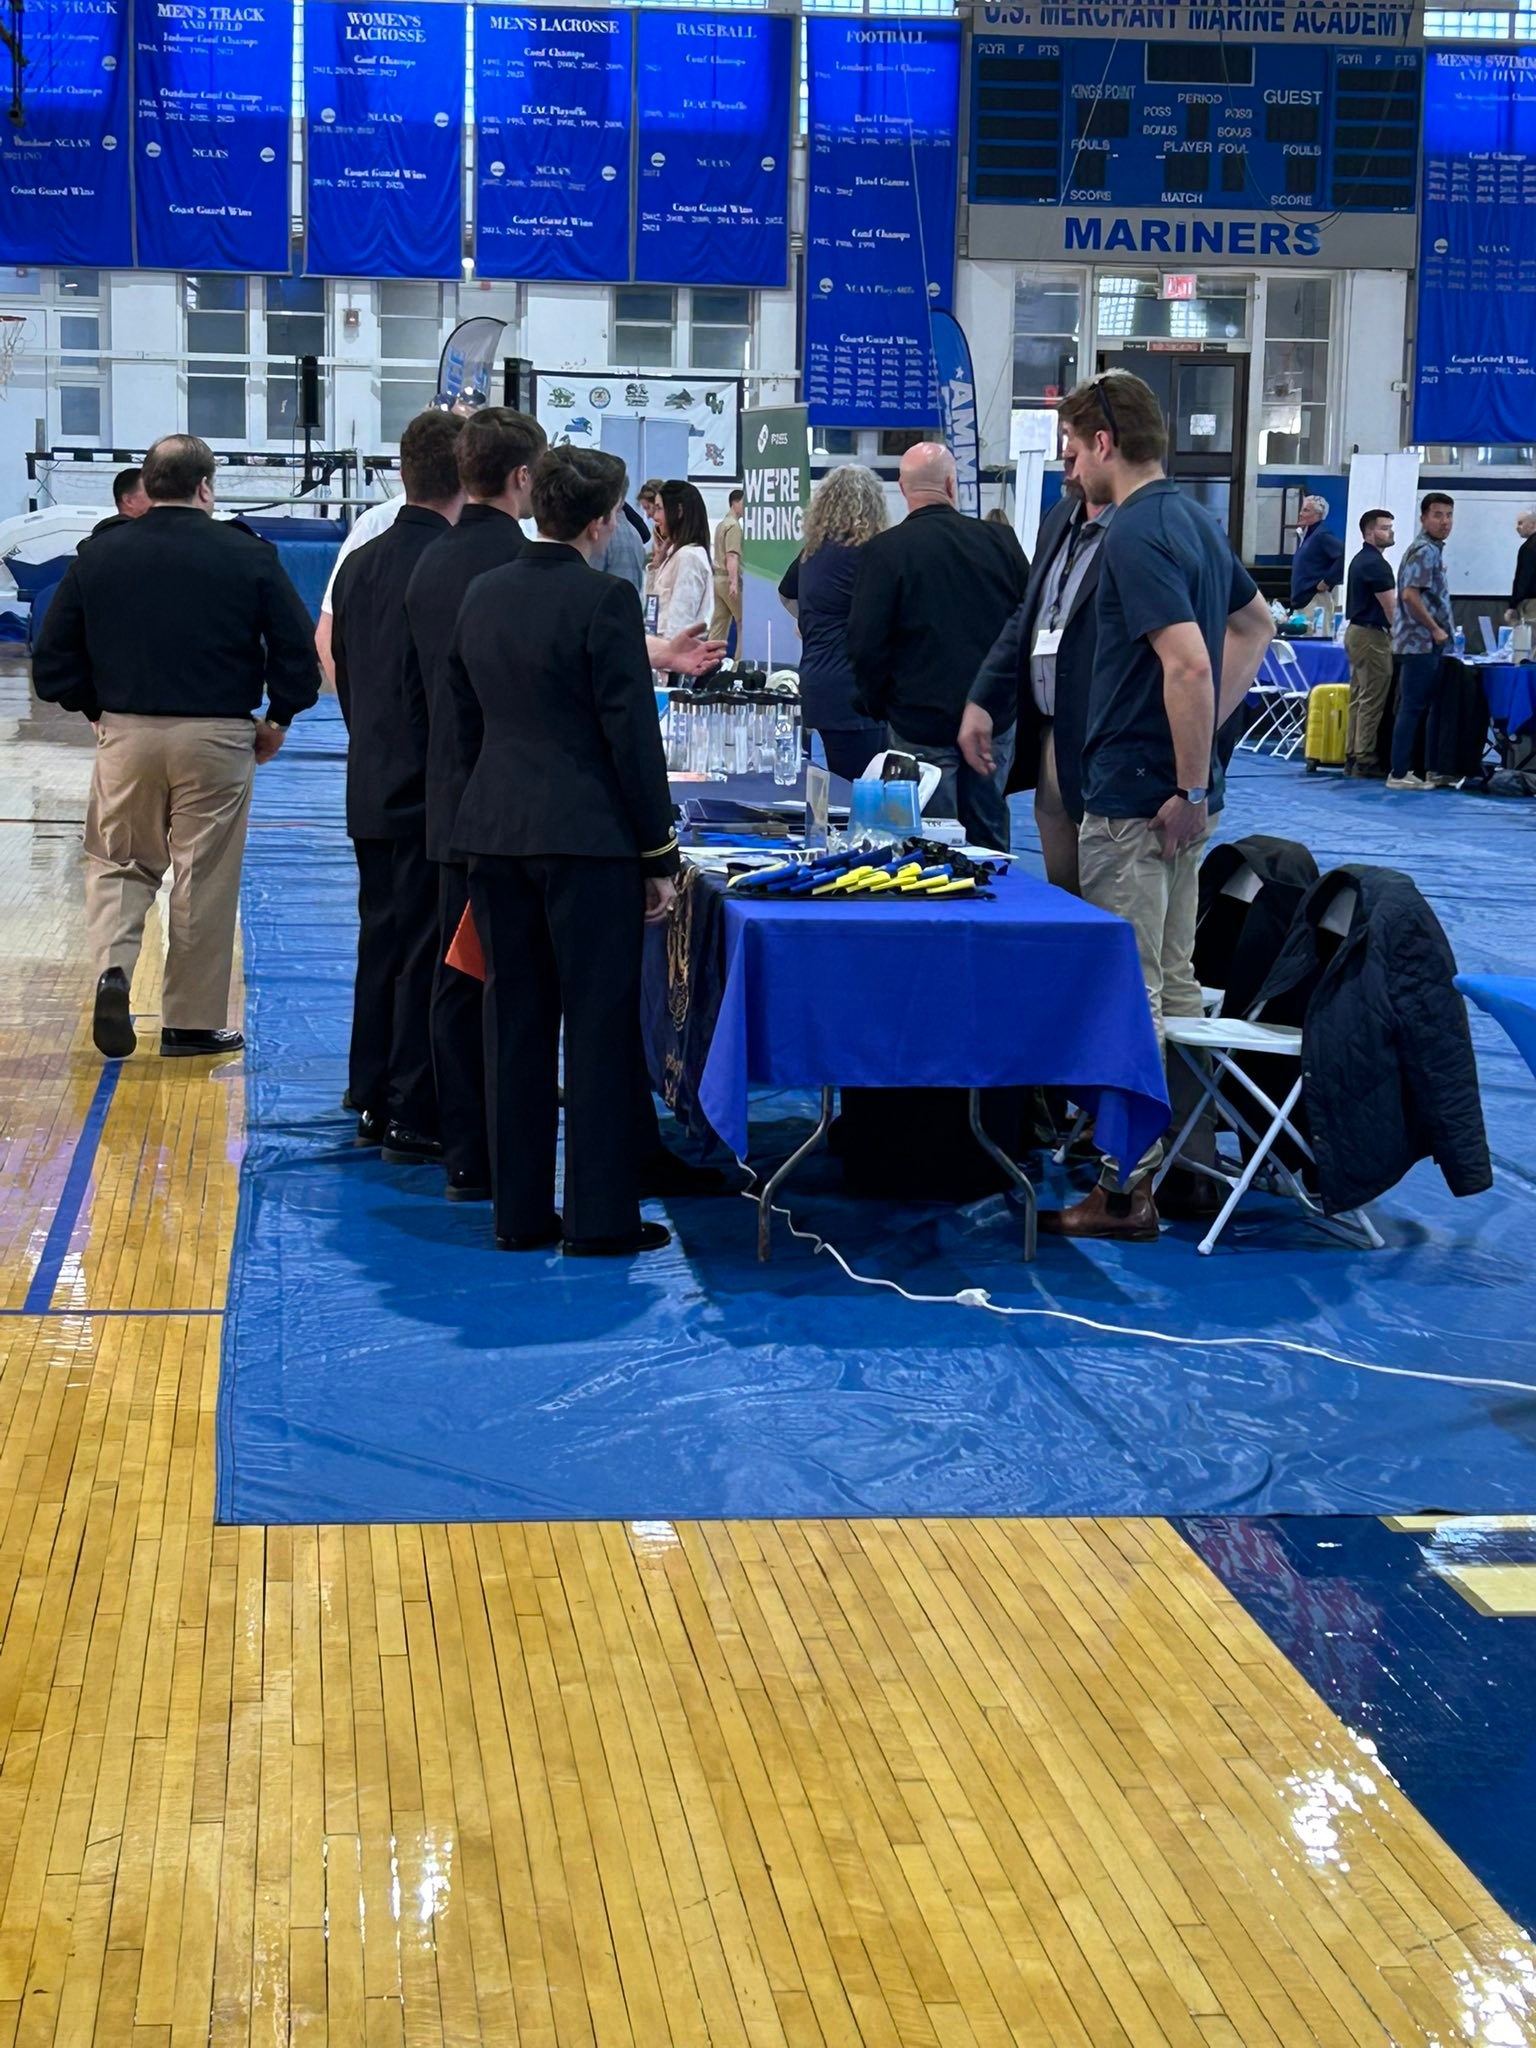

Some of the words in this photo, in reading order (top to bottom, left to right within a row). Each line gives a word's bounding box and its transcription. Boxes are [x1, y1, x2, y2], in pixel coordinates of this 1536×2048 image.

[63, 1, 118, 14] TRACK
[157, 3, 206, 19] MEN'S
[209, 7, 265, 22] TRACK
[347, 12, 421, 28] WOMEN'S
[490, 15, 538, 31] MEN'S
[540, 18, 620, 34] LACROSSE
[985, 4, 1031, 25] U.S.
[1040, 0, 1176, 29] MERCHANT
[1189, 0, 1285, 32] MARINE
[1293, 1, 1413, 37] ACADEMY
[181, 20, 205, 30] AND
[208, 21, 243, 31] FIELD
[676, 22, 757, 38] BASEBALL
[346, 26, 426, 43] LACROSSE
[846, 30, 927, 44] FOOTBALL
[978, 43, 1006, 55] PLYR
[1018, 44, 1025, 55] F
[1038, 45, 1060, 56] PTS
[1336, 53, 1363, 65] PLYR
[1436, 53, 1482, 68] MEN'S
[1071, 84, 1103, 100] KINGS
[1104, 84, 1136, 100] POINT
[1178, 93, 1223, 104] PERIOD
[1263, 89, 1323, 105] GUEST
[1144, 106, 1172, 117] POSS
[1142, 124, 1178, 135] BONUS
[1217, 126, 1252, 138] BONUS
[1071, 139, 1111, 150] FOULS
[1163, 141, 1213, 154] PLAYER
[1218, 142, 1250, 154] FOUL
[1282, 144, 1322, 156] FOULS
[1070, 190, 1112, 201] SCORE
[1161, 192, 1203, 204] MATCH
[1271, 195, 1313, 207] SCORE
[196, 205, 226, 216] Guard
[512, 215, 538, 225] Coast
[539, 215, 568, 226] Guard
[1064, 217, 1321, 256] MARINERS
[744, 467, 800, 503] WE'RE
[744, 506, 805, 541] HIRING
